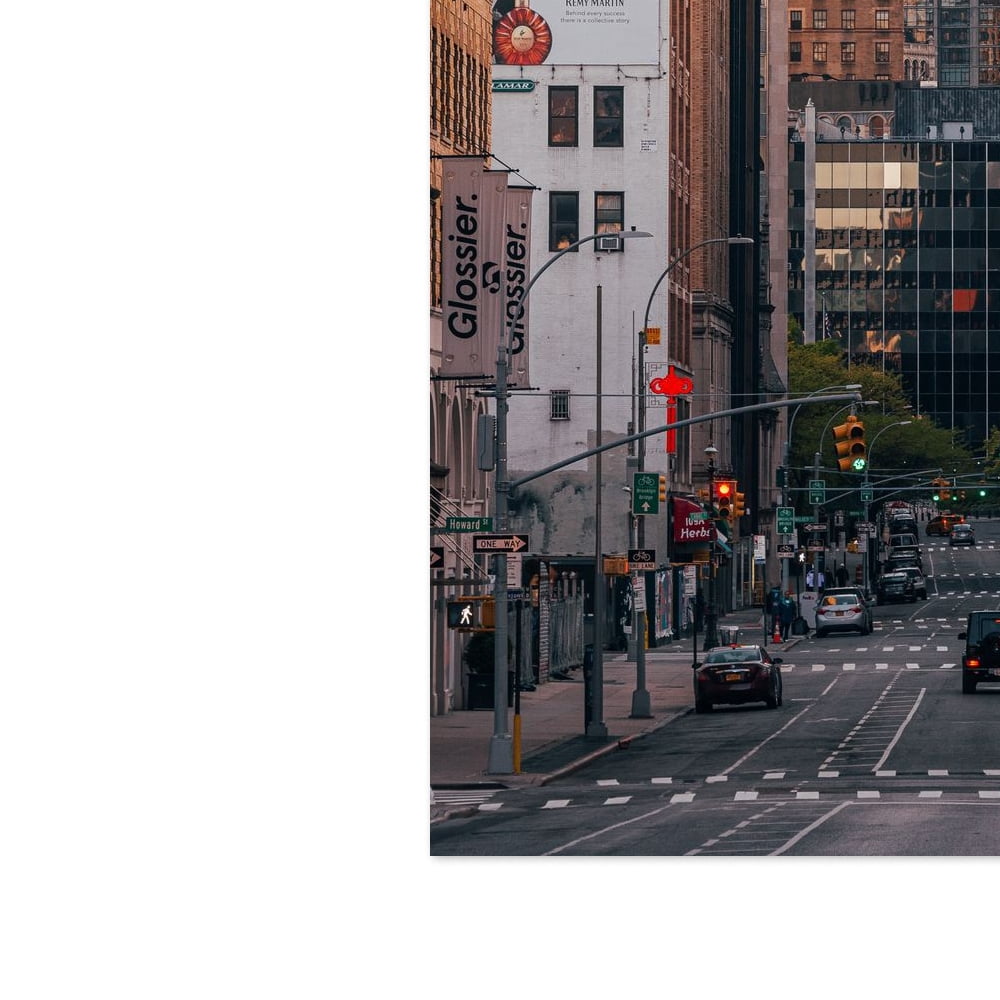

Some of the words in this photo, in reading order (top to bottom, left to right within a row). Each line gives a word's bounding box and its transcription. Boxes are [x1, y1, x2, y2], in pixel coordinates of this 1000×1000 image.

[448, 194, 478, 339] Glossier.
[450, 519, 480, 530] Howard
[480, 540, 497, 548] ONE
[503, 540, 521, 548] WAY
